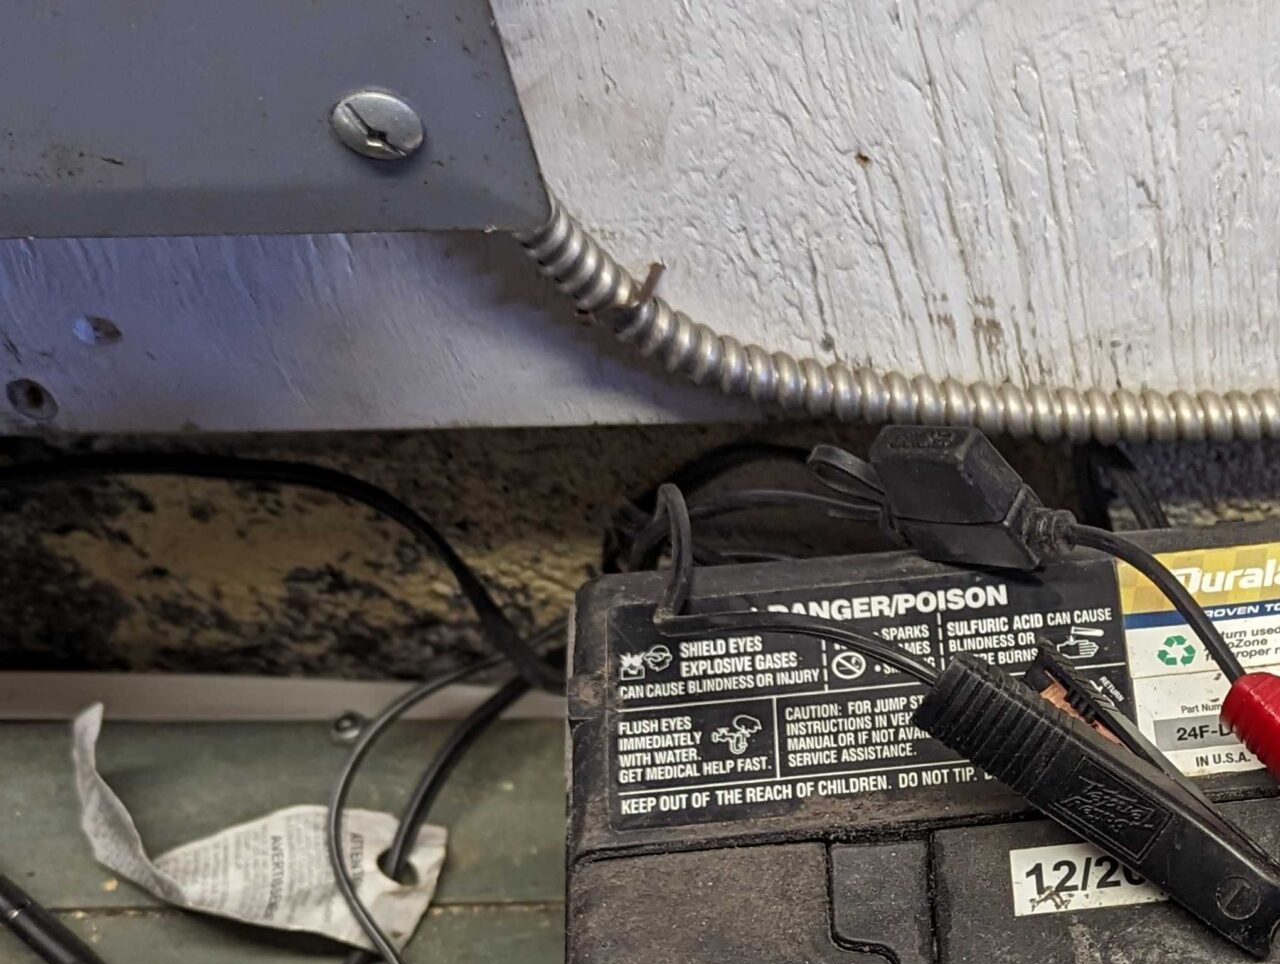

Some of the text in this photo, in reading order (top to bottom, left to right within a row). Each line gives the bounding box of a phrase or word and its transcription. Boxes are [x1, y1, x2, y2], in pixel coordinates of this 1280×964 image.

[1204, 604, 1260, 618] ROVEN
[881, 624, 930, 641] SPARKS
[946, 608, 1112, 637] SULFURIC ACID CAN CAUSE
[949, 636, 1015, 653] BLINDNESS
[1018, 632, 1036, 646] OR
[1222, 630, 1247, 639] turn
[1227, 638, 1268, 649] oZone
[679, 635, 762, 658] SHIELD EYES
[998, 648, 1039, 665] BURNS
[1235, 647, 1271, 659] roper
[680, 652, 797, 678] EXPLOSIVE GASES
[619, 668, 820, 700] CAN CAUSE BLINDNESS OR INJURY
[1099, 675, 1125, 702] RETURN
[785, 696, 907, 721] CAUTION: FOR JUMP
[1181, 703, 1222, 714] Part Num
[618, 716, 692, 736] FLUSH EYES
[786, 714, 888, 737] INSTRUCTIONS IN
[618, 731, 702, 752] IMMEDIATELY
[787, 734, 838, 751] MANUAL
[838, 732, 855, 747] OR
[857, 731, 869, 744] IF
[871, 728, 896, 744] NOT
[618, 748, 702, 768] WITH WATER.
[788, 742, 917, 768] SERVICE ASSISTANCE.
[1195, 751, 1251, 768] IN U.S.A.
[618, 756, 773, 784] GET MEDICAL HELP FAST.
[621, 797, 657, 816] KEEP
[659, 794, 689, 812] OUT
[691, 792, 711, 809] OF
[715, 788, 743, 806] THE
[745, 783, 793, 803] REACH
[796, 782, 814, 798] OF
[818, 774, 892, 797] CHILDREN.
[898, 772, 918, 788] DO
[922, 769, 949, 786] NOT
[952, 766, 977, 782] TIP.
